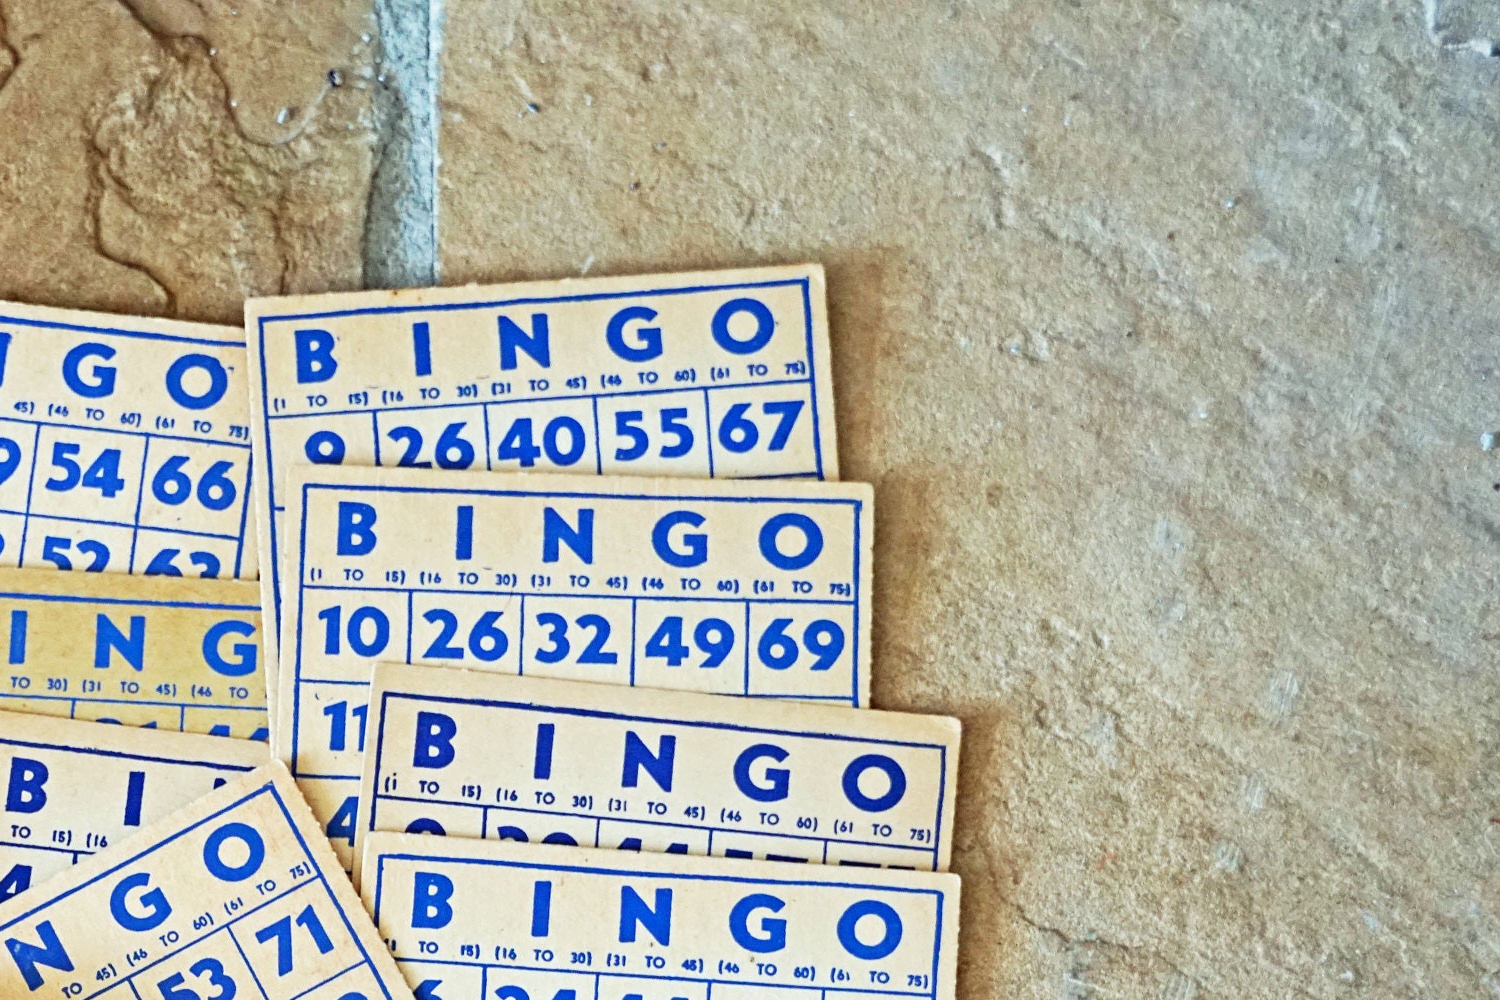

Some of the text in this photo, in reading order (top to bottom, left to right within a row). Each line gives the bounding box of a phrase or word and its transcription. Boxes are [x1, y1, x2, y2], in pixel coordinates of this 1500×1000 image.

[45, 442, 125, 498] 54
[152, 455, 237, 511] 66
[318, 605, 845, 671] 10 26 32 49 69
[496, 787, 705, 821] (16 TO 30) (31 TO 45)
[255, 904, 334, 977] 71
